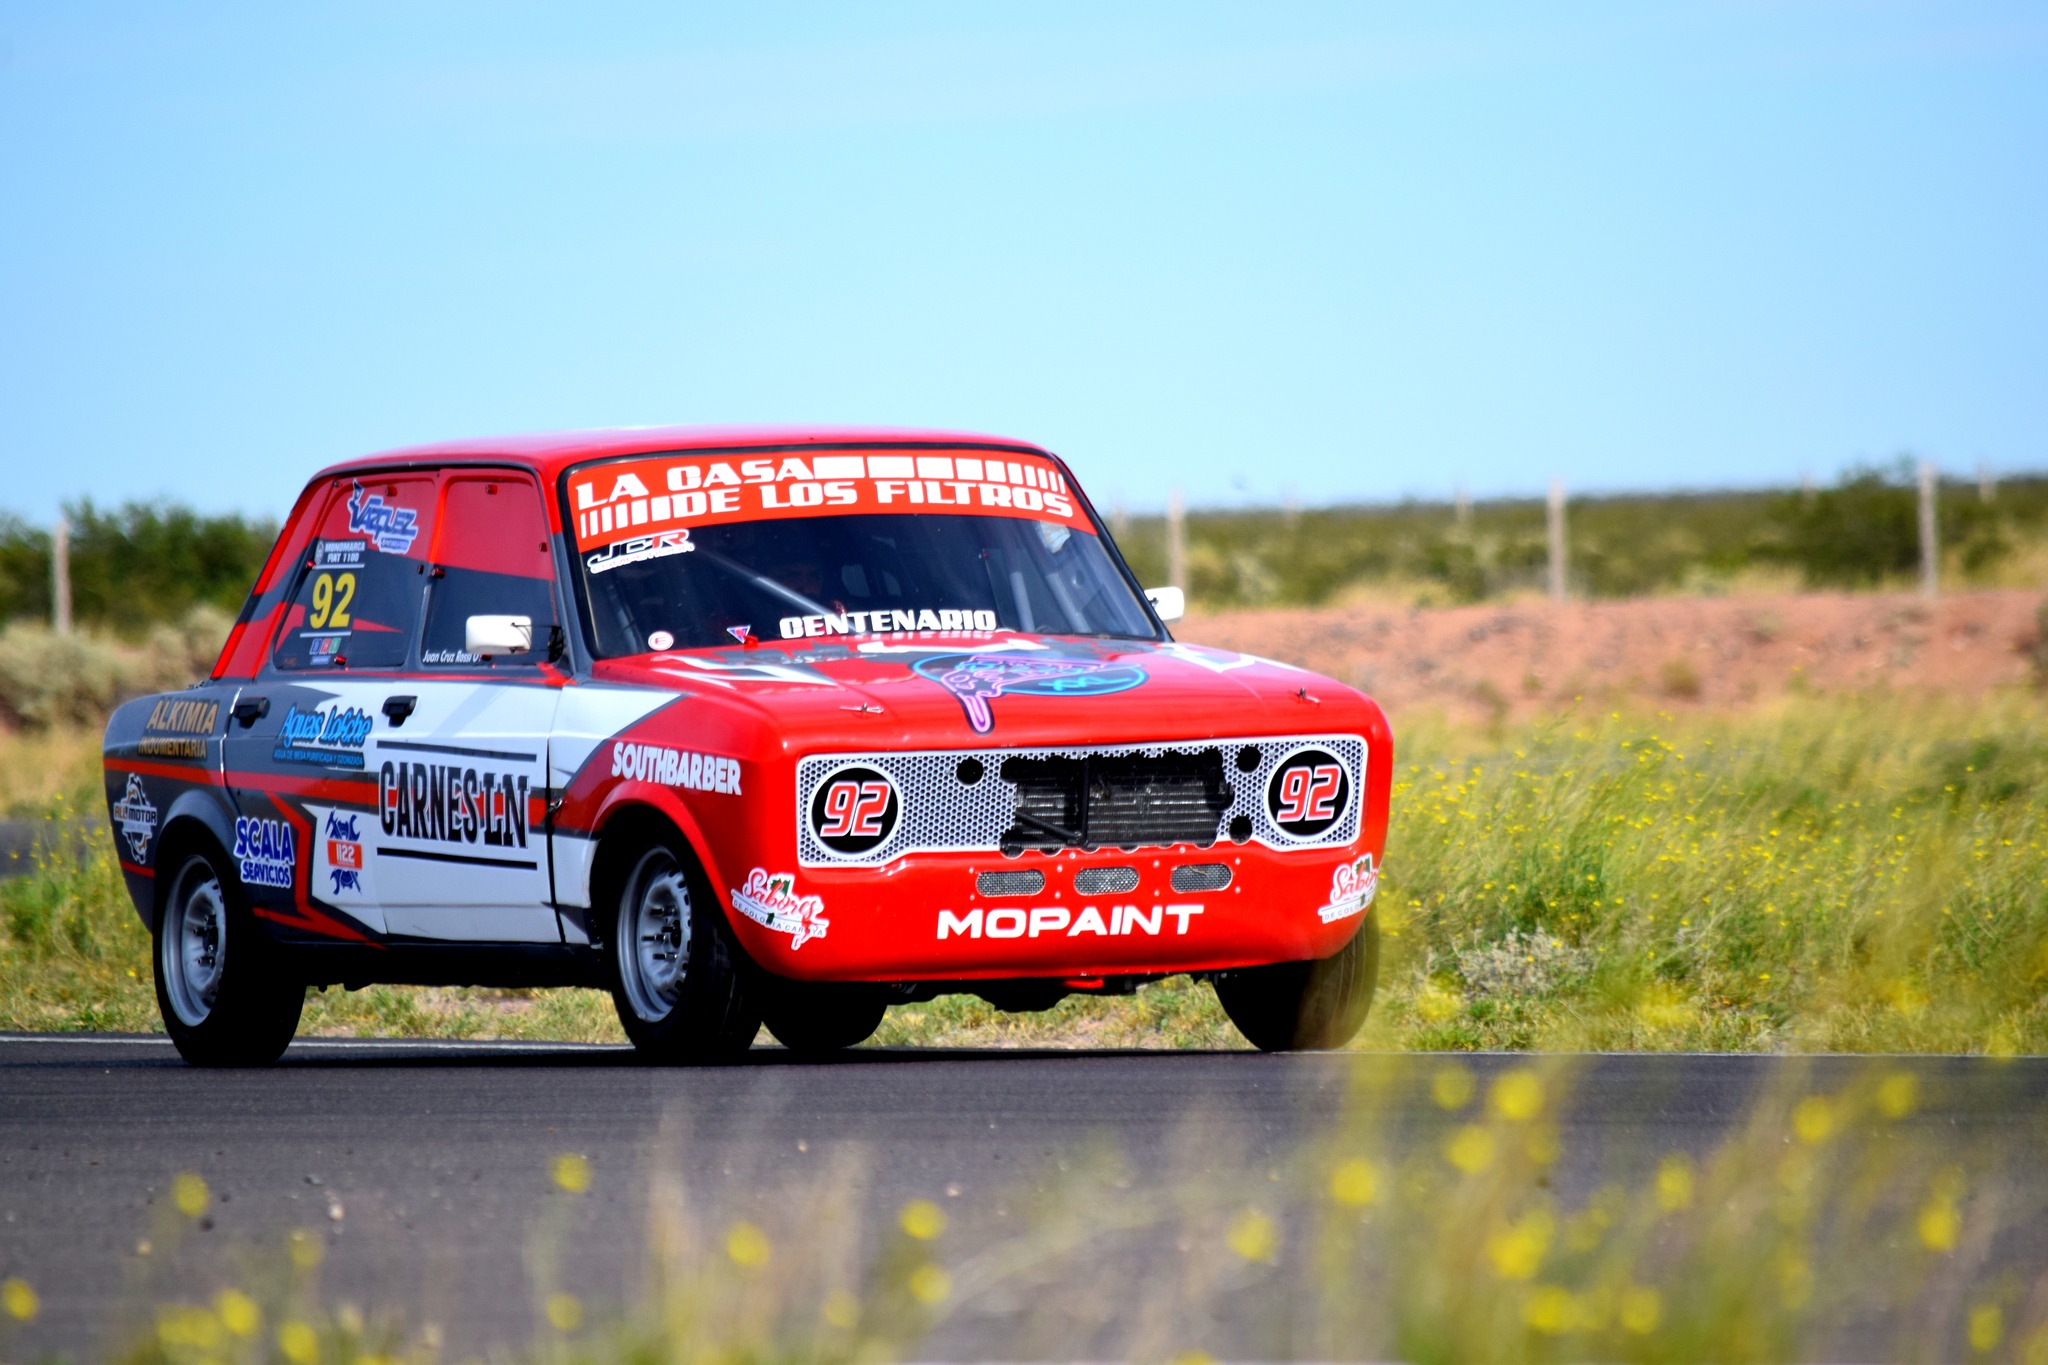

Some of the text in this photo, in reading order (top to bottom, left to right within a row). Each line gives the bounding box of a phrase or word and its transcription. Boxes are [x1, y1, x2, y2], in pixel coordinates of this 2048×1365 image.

[576, 458, 814, 510] LA CASA
[670, 481, 1074, 518] DE LOS FILTROS
[310, 572, 356, 629] 92
[779, 609, 997, 639] CENTENARIO
[422, 649, 440, 663] Juan
[440, 649, 456, 663] Cruz
[455, 649, 473, 663] Rossi
[145, 700, 218, 735] ALKIMIA
[278, 705, 325, 748] Aguas
[138, 736, 207, 758] INDUMENTARIA
[611, 742, 742, 796] SOUTHBARBER
[379, 760, 479, 844] CARNES
[820, 781, 891, 837] 92
[1277, 764, 1341, 823] 92
[128, 808, 157, 824] MOTOR
[234, 817, 294, 864] SCALA
[336, 843, 356, 863] 1122
[242, 861, 290, 886] SERVICIOS
[744, 907, 782, 929] COLOIA
[784, 924, 824, 936] CARYA
[937, 904, 1205, 940] MOPAINT
